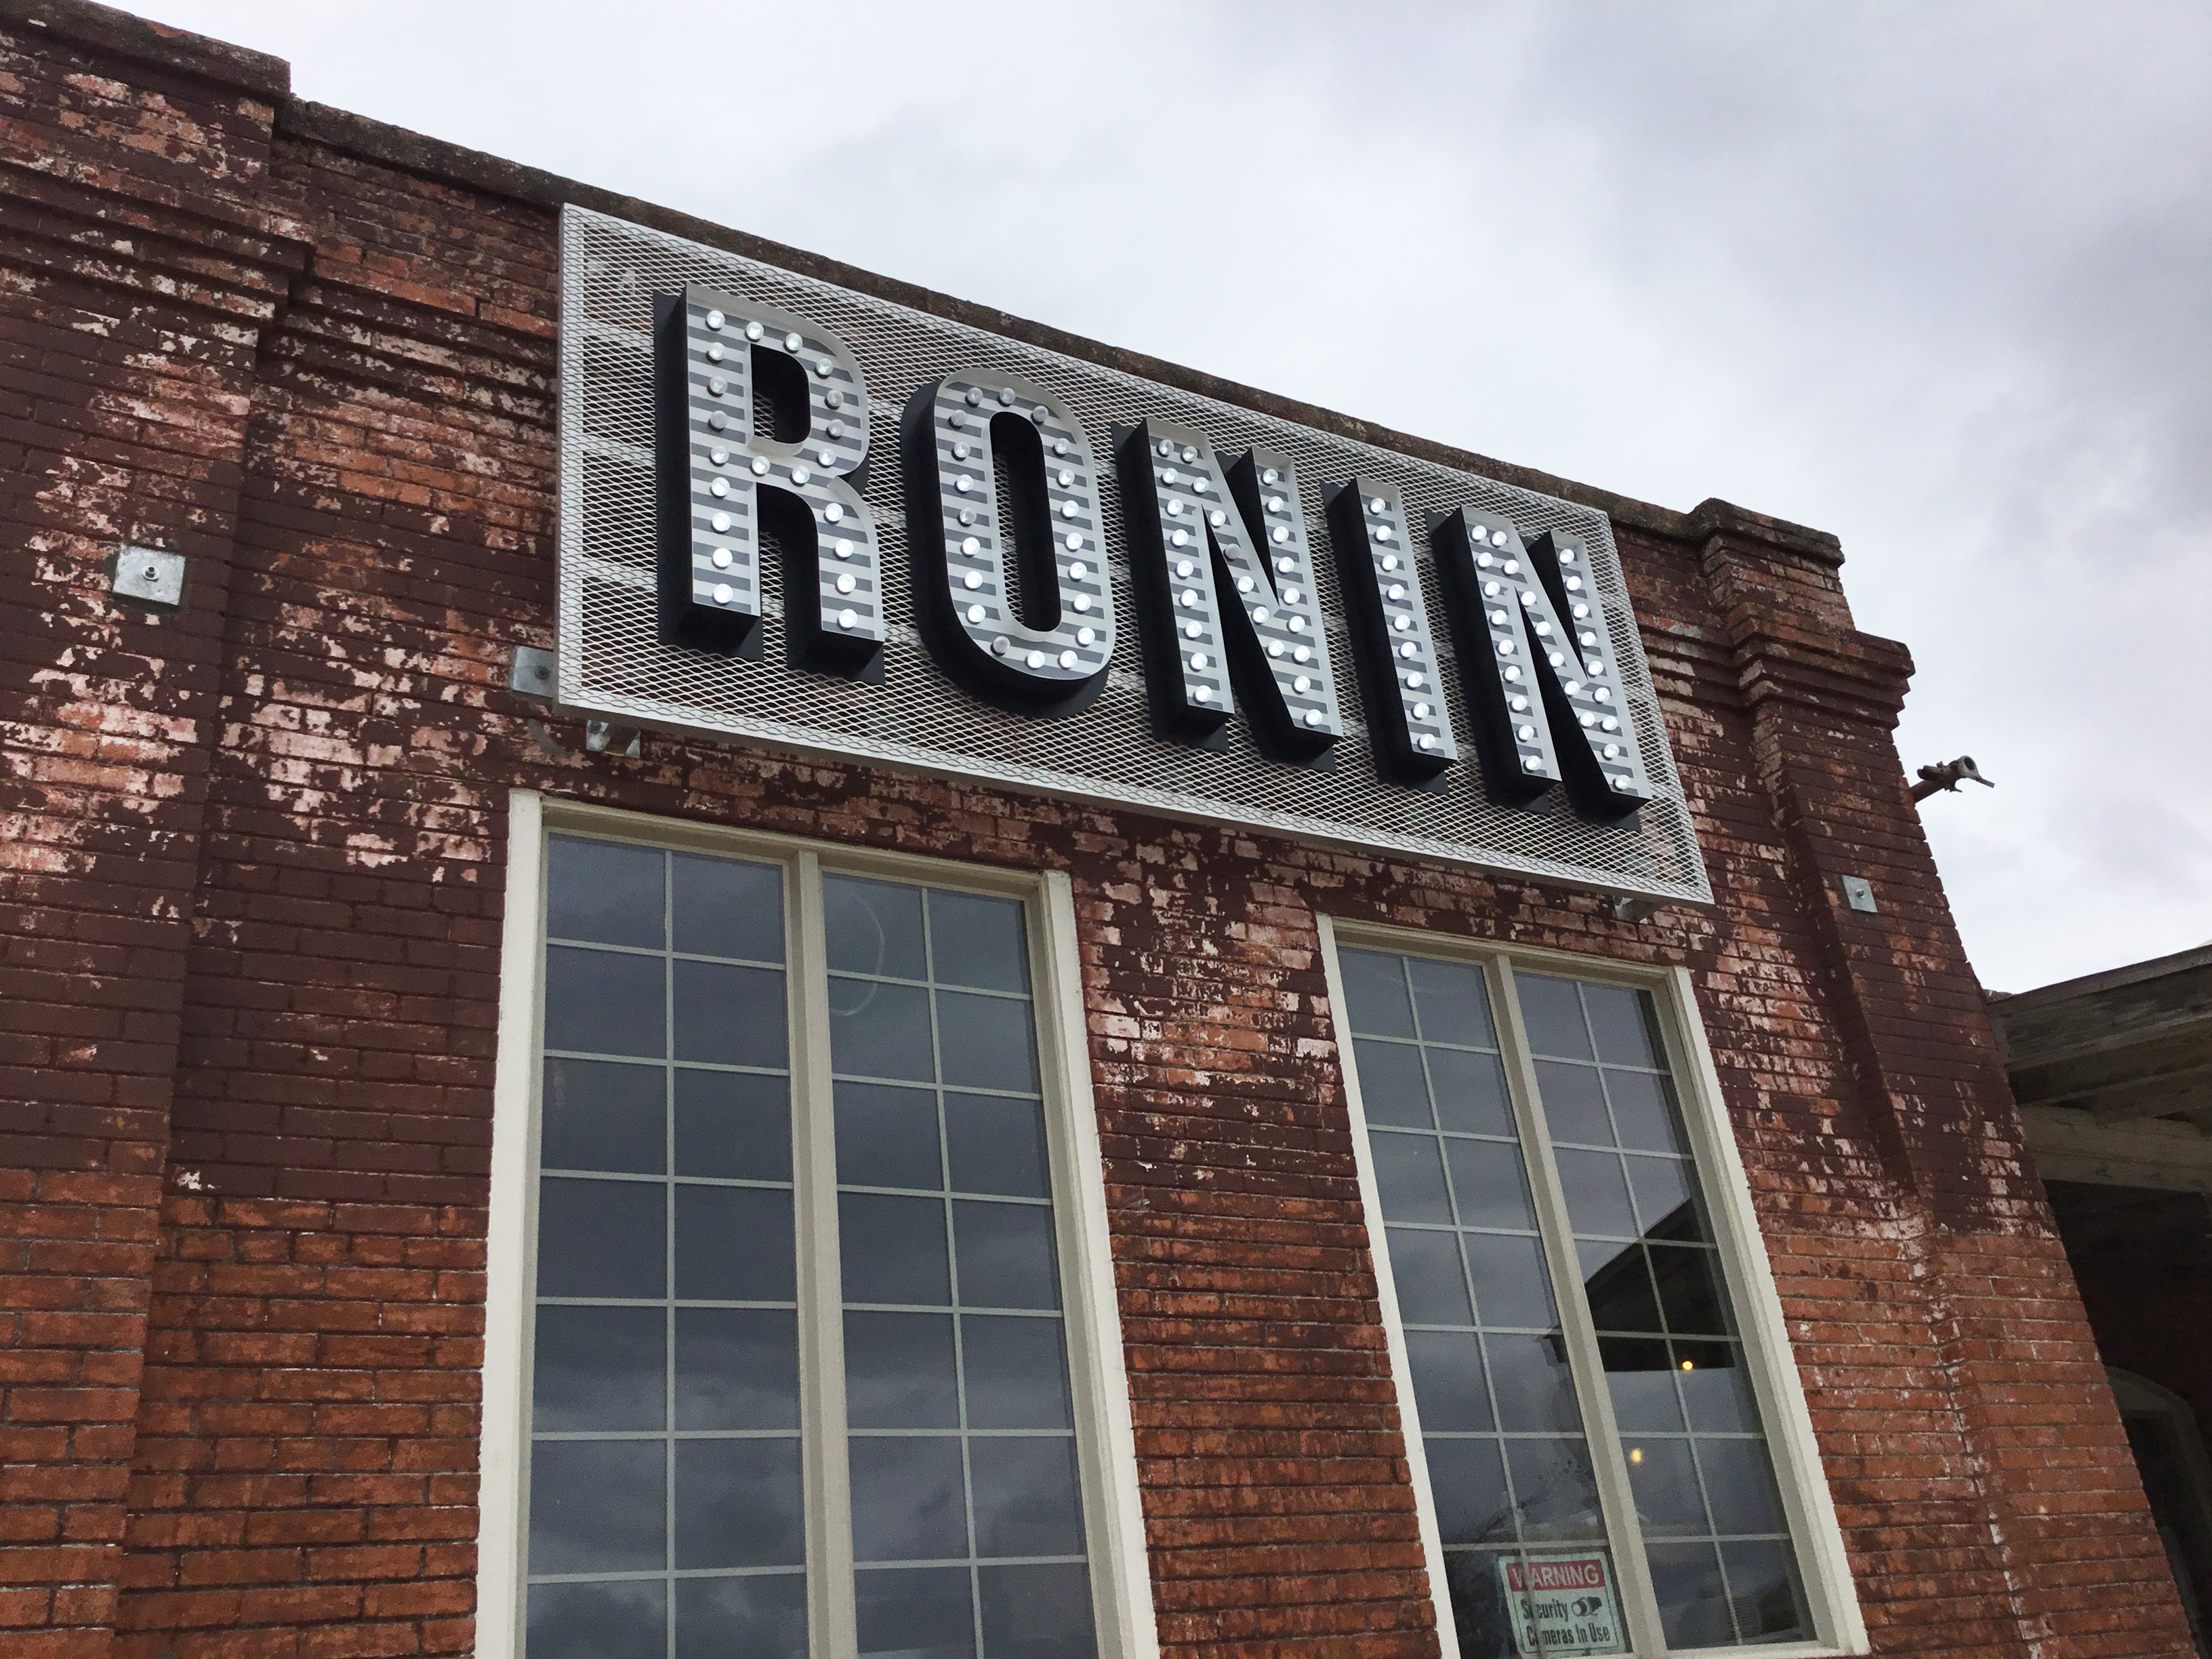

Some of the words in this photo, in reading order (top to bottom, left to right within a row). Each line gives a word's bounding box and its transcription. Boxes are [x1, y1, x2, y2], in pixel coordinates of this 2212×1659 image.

[680, 282, 1652, 804] RONIN
[1511, 1564, 1599, 1588] WARNING
[1575, 1624, 1588, 1643] In
[1588, 1622, 1610, 1642] Use
